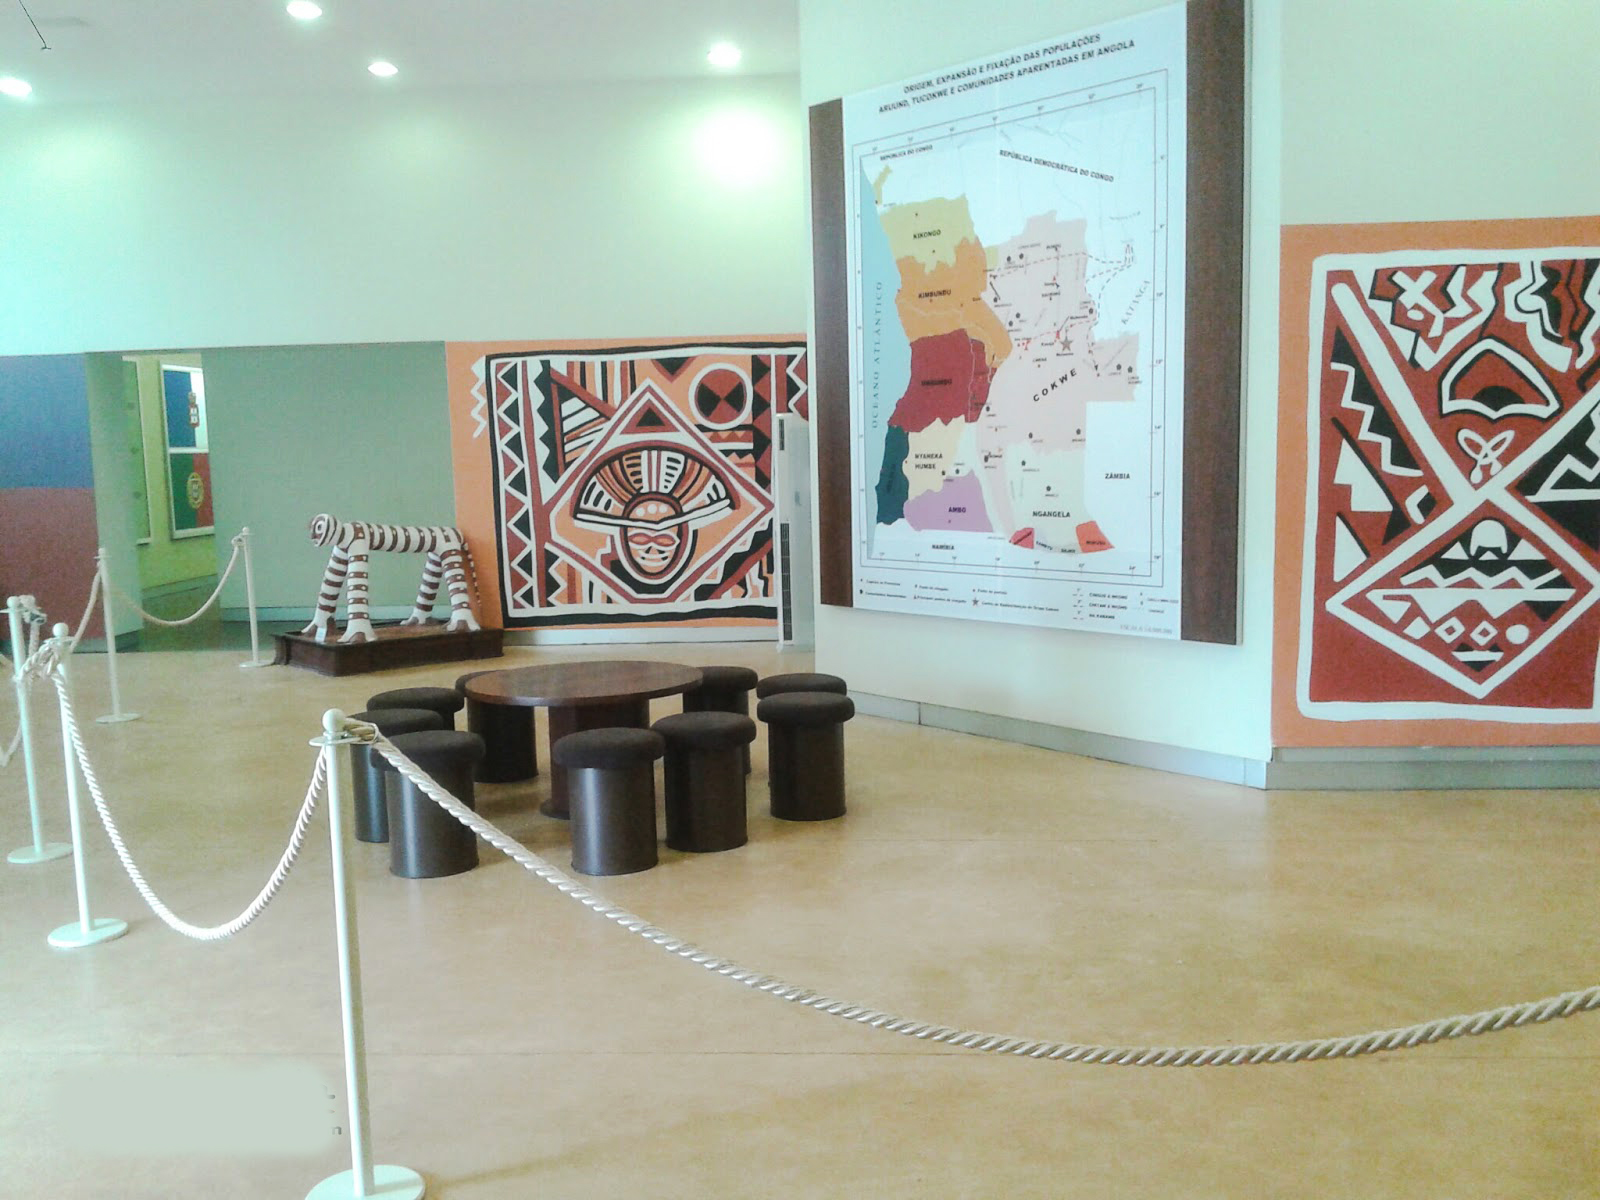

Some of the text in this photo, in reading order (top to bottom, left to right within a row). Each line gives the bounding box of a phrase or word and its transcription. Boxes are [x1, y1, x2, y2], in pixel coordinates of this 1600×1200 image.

[936, 67, 977, 86] EXPANSÃO
[978, 65, 984, 74] E
[986, 54, 1021, 72] FIXAÇÃO
[1023, 49, 1040, 61] DAS
[1043, 33, 1101, 56] POPULAÇÕES
[950, 86, 955, 95] E
[957, 71, 1014, 93] COMUNIDADES
[1017, 54, 1079, 77] APARENTADAS
[1082, 50, 1095, 61] EM
[1097, 39, 1135, 56] ANGOLA
[999, 149, 1115, 183] REPÚBLICA DEMOCRÁTICA DO CONGO
[912, 228, 942, 240] KIKONGO
[1032, 368, 1078, 403] COKWE
[1104, 472, 1130, 480] ZÂMBIA
[1032, 510, 1071, 518] NGANGELA
